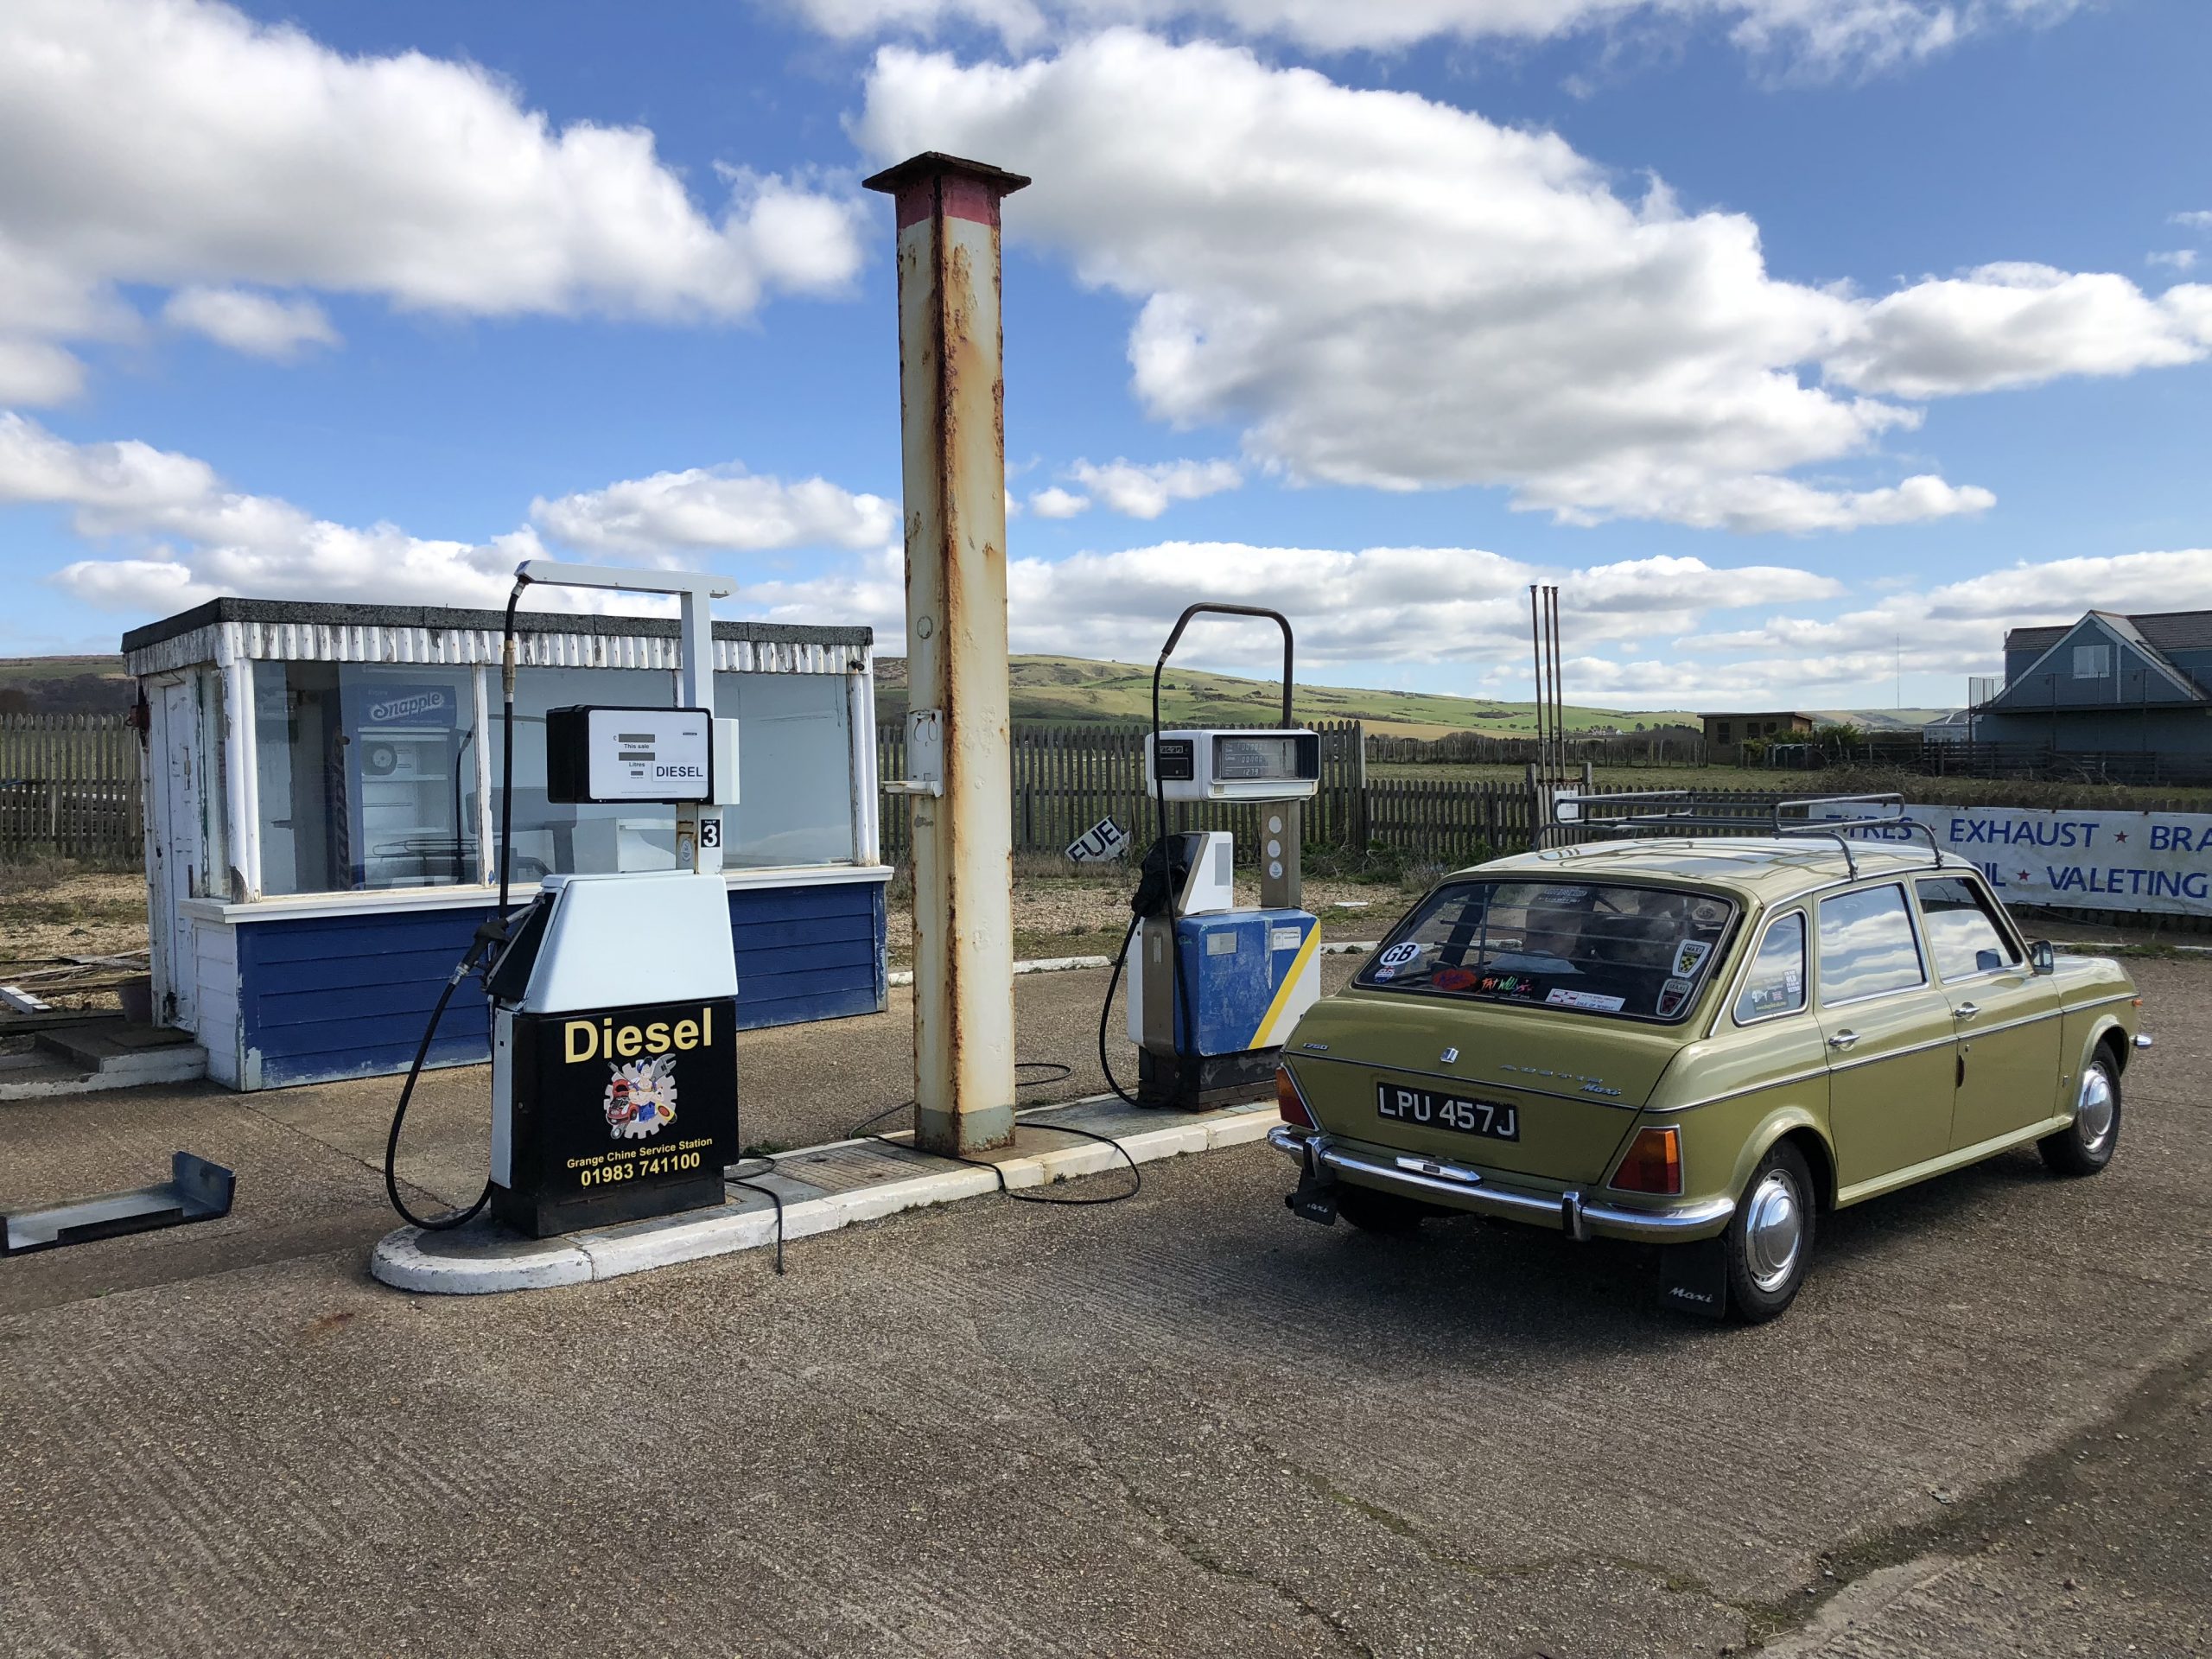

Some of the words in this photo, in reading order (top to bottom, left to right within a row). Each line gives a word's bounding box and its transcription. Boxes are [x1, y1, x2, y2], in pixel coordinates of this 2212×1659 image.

[373, 691, 442, 719] Snapple
[656, 766, 704, 778] DIESEL
[703, 824, 718, 847] 3
[1949, 818, 2101, 848] EXHAUST
[2150, 825, 2212, 852] BRA
[2046, 866, 2209, 899] VALETING
[1383, 944, 1418, 963] GB
[564, 1007, 712, 1064] Diesel
[1580, 1083, 1622, 1096] Maxi
[1379, 1087, 1431, 1122] LPU
[1439, 1099, 1515, 1136] 457J
[567, 1154, 605, 1169] Grange
[607, 1149, 637, 1162] Chine
[639, 1143, 677, 1156] Service
[678, 1138, 713, 1150] Station
[581, 1163, 634, 1186] 01983
[639, 1152, 701, 1177] 741100
[1668, 1287, 1713, 1303] Maxi
